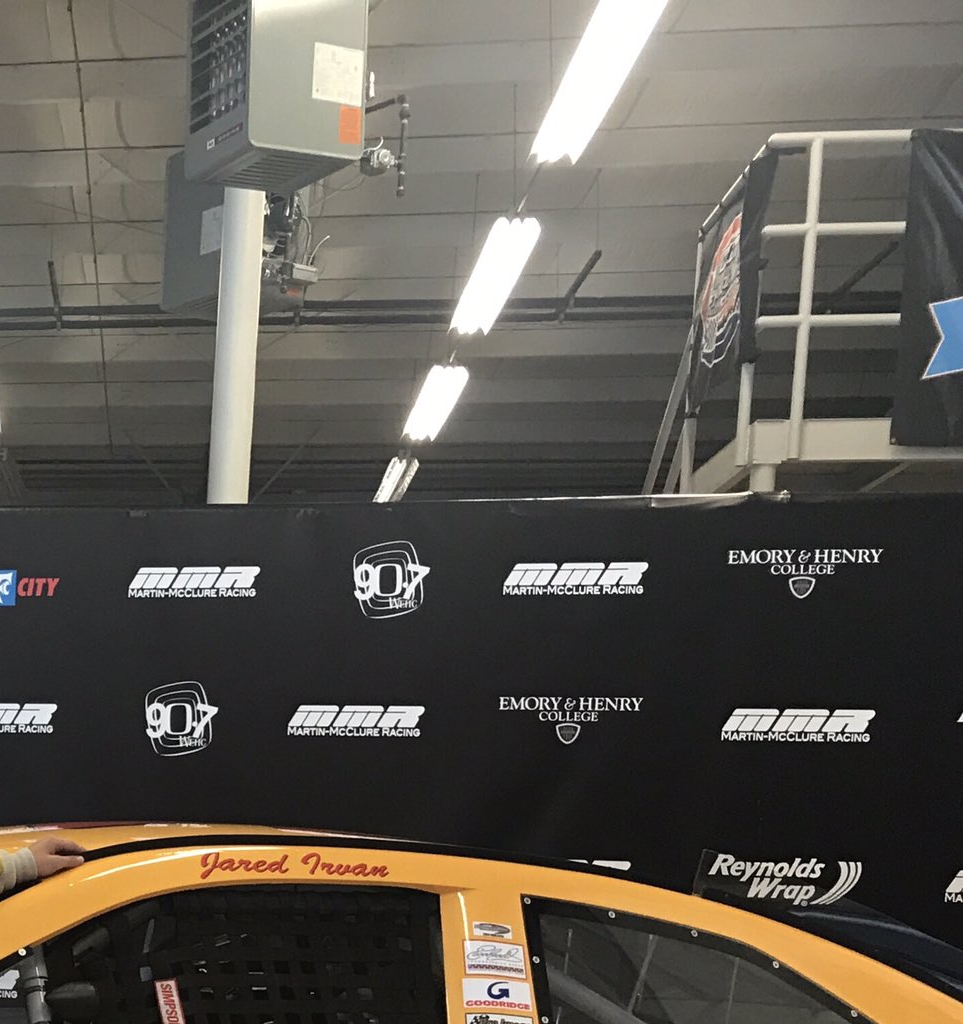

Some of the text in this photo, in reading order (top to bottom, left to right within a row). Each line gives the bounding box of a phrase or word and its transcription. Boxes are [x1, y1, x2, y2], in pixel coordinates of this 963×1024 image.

[728, 548, 883, 565] EMORY & HENRY
[771, 564, 835, 576] COLLEGE
[17, 576, 60, 597] CITY
[603, 584, 644, 595] RACING
[219, 588, 257, 598] RACING
[499, 696, 644, 713] EMORY & HENRY
[538, 711, 599, 723] COLLEGE
[18, 723, 53, 734] RACING
[381, 727, 421, 738] RACING
[827, 732, 871, 743] RACING
[200, 852, 389, 879] Jared Irvan
[708, 854, 826, 880] Reynolds
[747, 877, 816, 906] Wrap
[466, 1000, 530, 1010] GOODRIDGE
